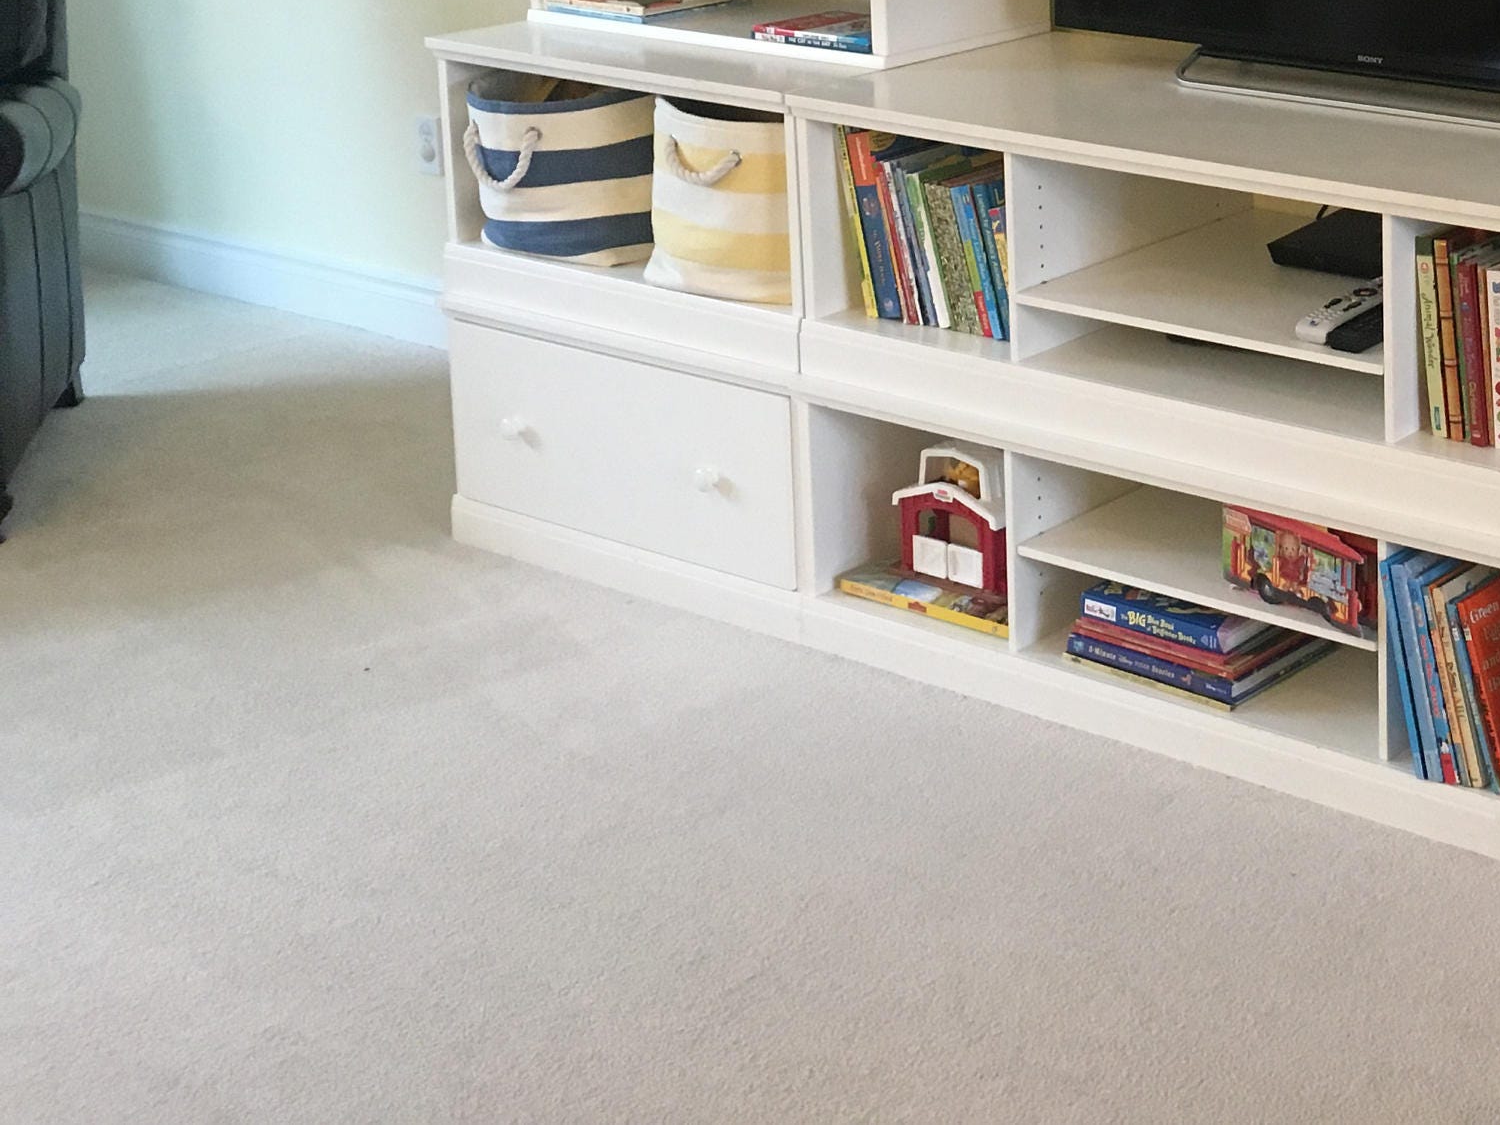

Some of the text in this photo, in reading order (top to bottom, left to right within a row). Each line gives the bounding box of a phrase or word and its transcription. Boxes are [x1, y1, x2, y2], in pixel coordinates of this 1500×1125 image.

[1357, 54, 1384, 64] SONY
[1421, 292, 1435, 330] Animal
[1128, 611, 1147, 626] BIG
[1469, 600, 1500, 624] Green
